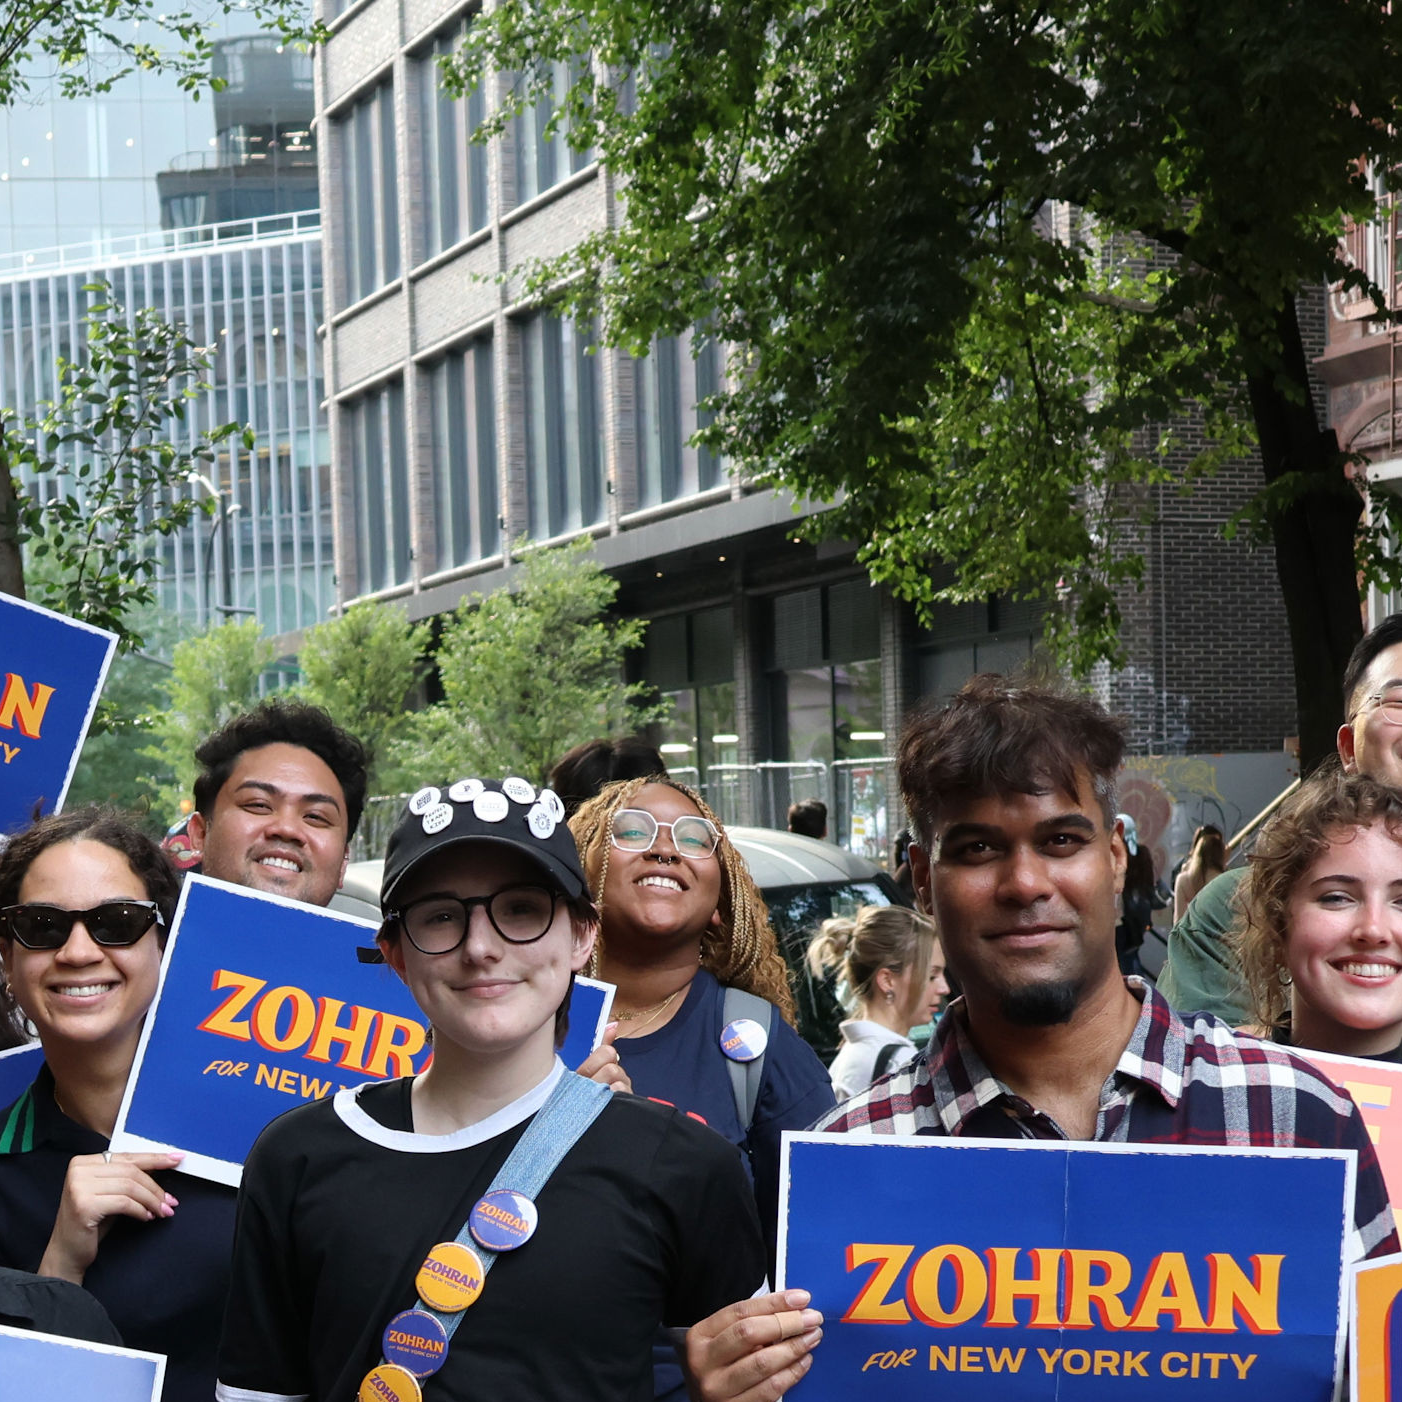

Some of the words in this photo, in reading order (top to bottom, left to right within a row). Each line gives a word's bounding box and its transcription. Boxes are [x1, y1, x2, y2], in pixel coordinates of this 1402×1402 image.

[197, 969, 434, 1079] ZOHR
[202, 1059, 249, 1079] FOR
[254, 1063, 333, 1101] NEW
[476, 1201, 529, 1233] ZOHRAN
[422, 1257, 480, 1291] ZOHRAN
[840, 1243, 1286, 1335] ZOHRAN
[388, 1330, 445, 1354] ZOHRAN
[862, 1348, 918, 1372] FOR
[929, 1345, 1027, 1373] NEW
[1037, 1348, 1150, 1377] YORK
[1160, 1352, 1258, 1380] CITY
